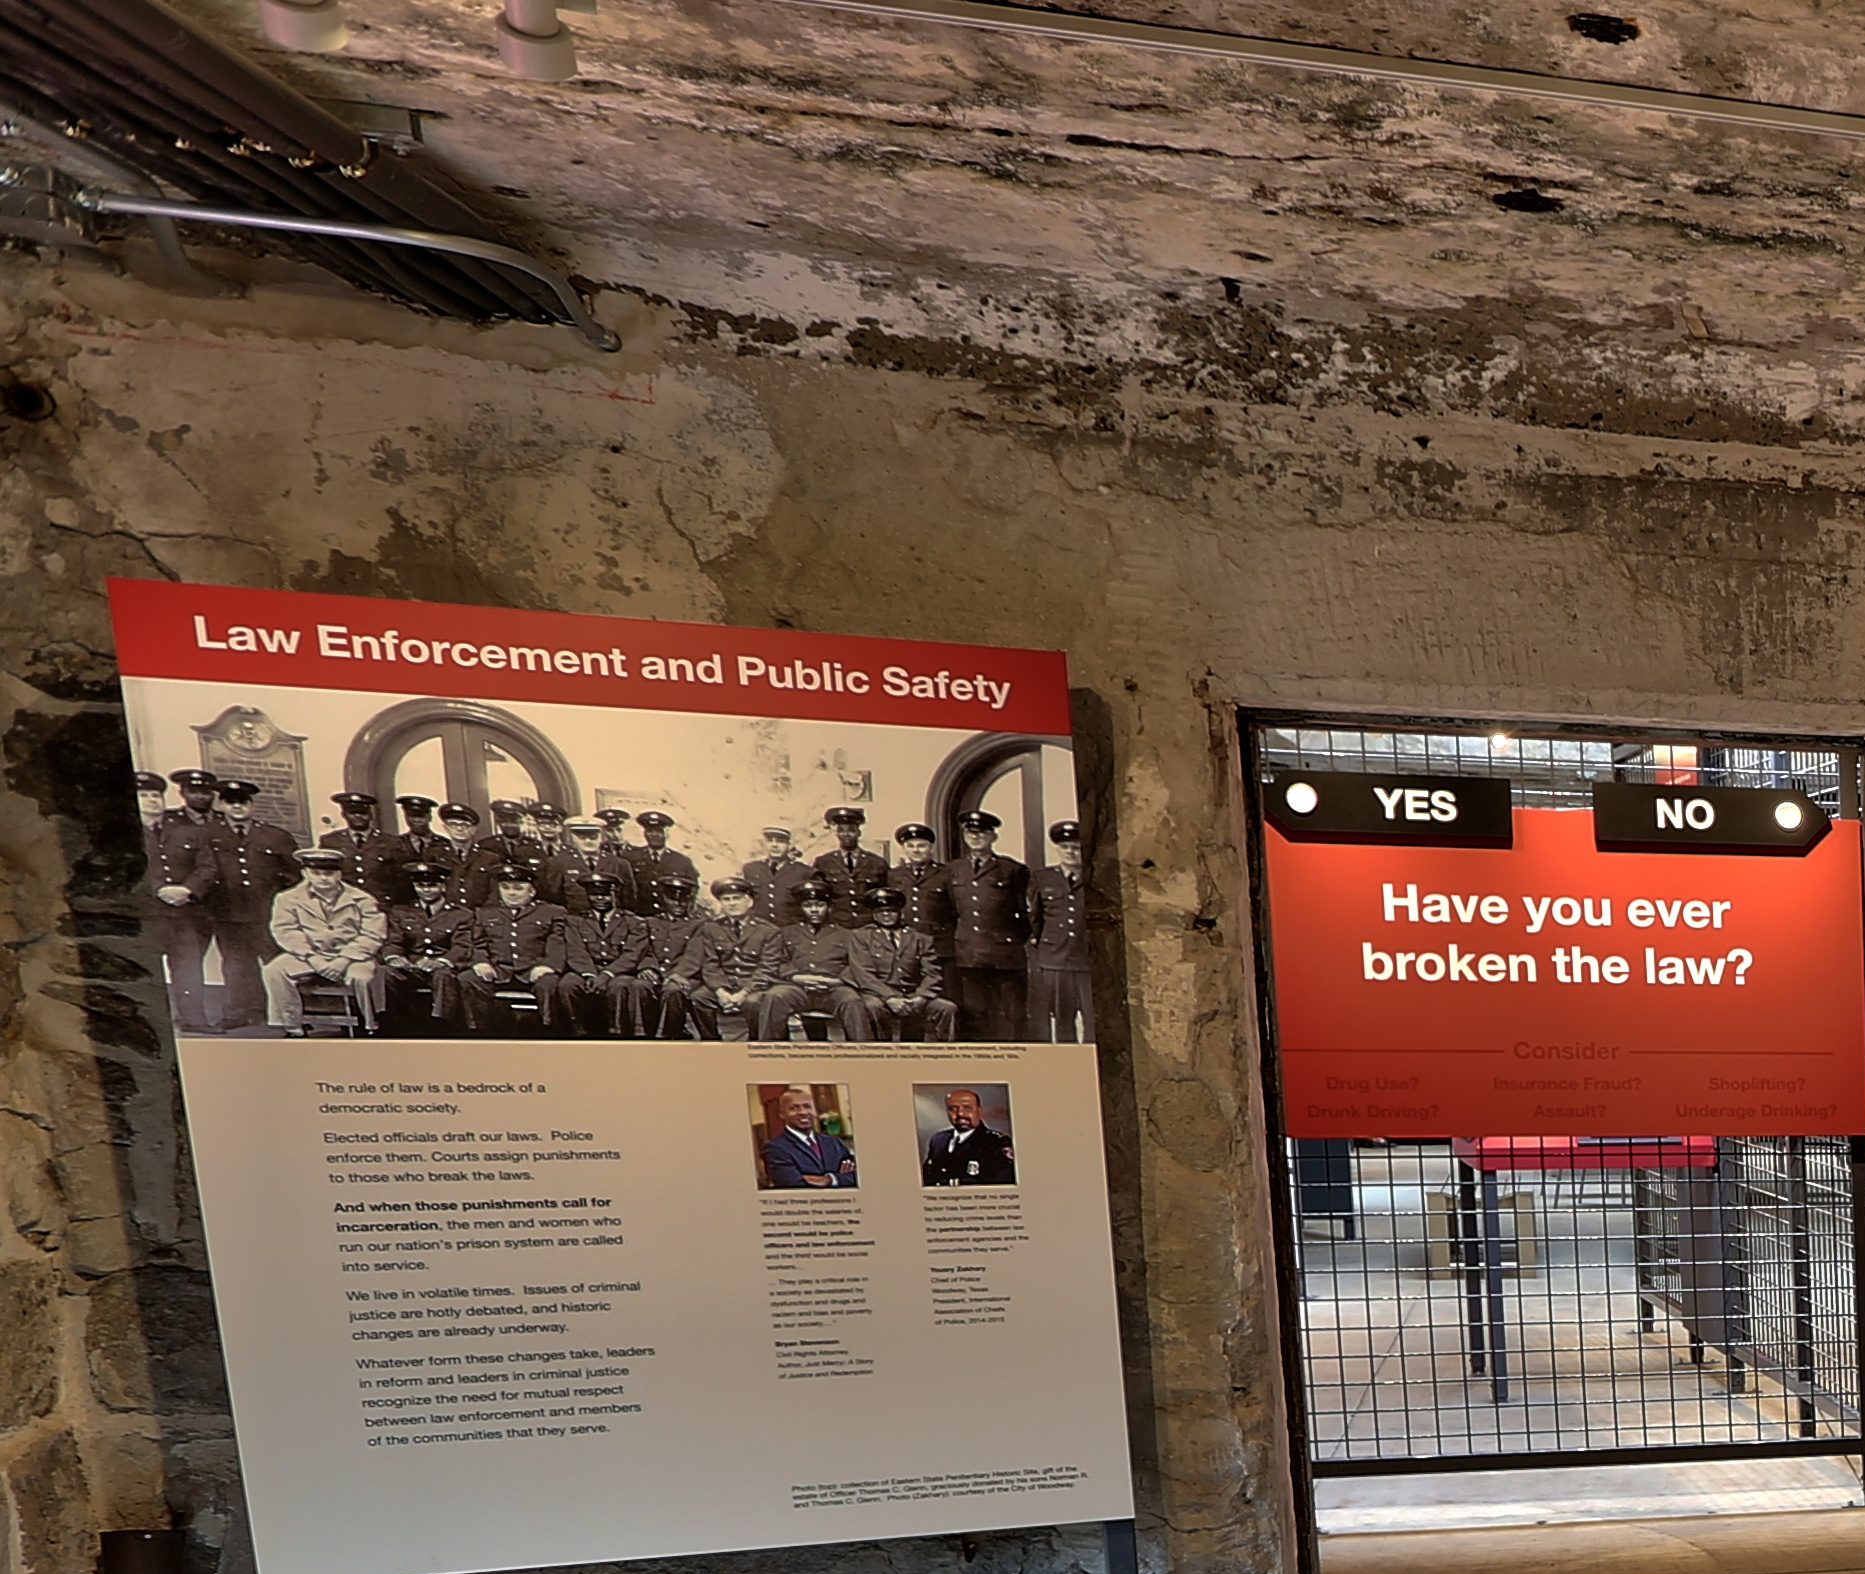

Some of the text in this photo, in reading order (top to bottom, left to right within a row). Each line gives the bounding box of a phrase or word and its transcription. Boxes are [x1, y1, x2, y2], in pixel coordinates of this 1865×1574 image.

[194, 616, 1010, 709] Law Enforcement and Public Safety
[1373, 787, 1457, 821] YES
[1656, 798, 1714, 829] NO
[1383, 883, 1730, 932] Have you ever
[1363, 942, 1752, 985] broken the law?
[1513, 1041, 1619, 1059] Consider
[315, 1082, 344, 1093] The
[348, 1083, 375, 1092] rule
[380, 1083, 393, 1093] of
[398, 1083, 423, 1092] law
[428, 1083, 440, 1092] is
[456, 1083, 515, 1092] bedrock
[519, 1082, 532, 1092] of
[1326, 1076, 1419, 1093] Drug Use?
[1493, 1077, 1641, 1090] Insurance Fraud?
[1709, 1077, 1805, 1093] Shoplifting?
[319, 1103, 460, 1114] democratic society.
[1307, 1104, 1438, 1121] Drunk Driving?
[1533, 1104, 1605, 1117] Assault?
[1675, 1104, 1837, 1120] Underage Drinking?
[323, 1130, 593, 1143] Elected officials draft our laws. Police
[326, 1150, 620, 1163] enforce them. Courts assign punishments
[329, 1170, 534, 1183] to those who break the laws.
[334, 1197, 611, 1212] And when those punishments call for
[336, 1220, 442, 1232] incarceration,
[446, 1220, 469, 1229] the
[508, 1218, 534, 1228] and
[538, 1219, 588, 1227] women
[592, 1217, 621, 1225] who
[339, 1235, 623, 1252] run our nation's prison system are called
[342, 1260, 428, 1271] into service.
[345, 1281, 640, 1300] We live in volatile times. Issues of criminal
[349, 1302, 610, 1322] justice are hotly debated, and historic
[352, 1323, 568, 1341] changes are already underway.
